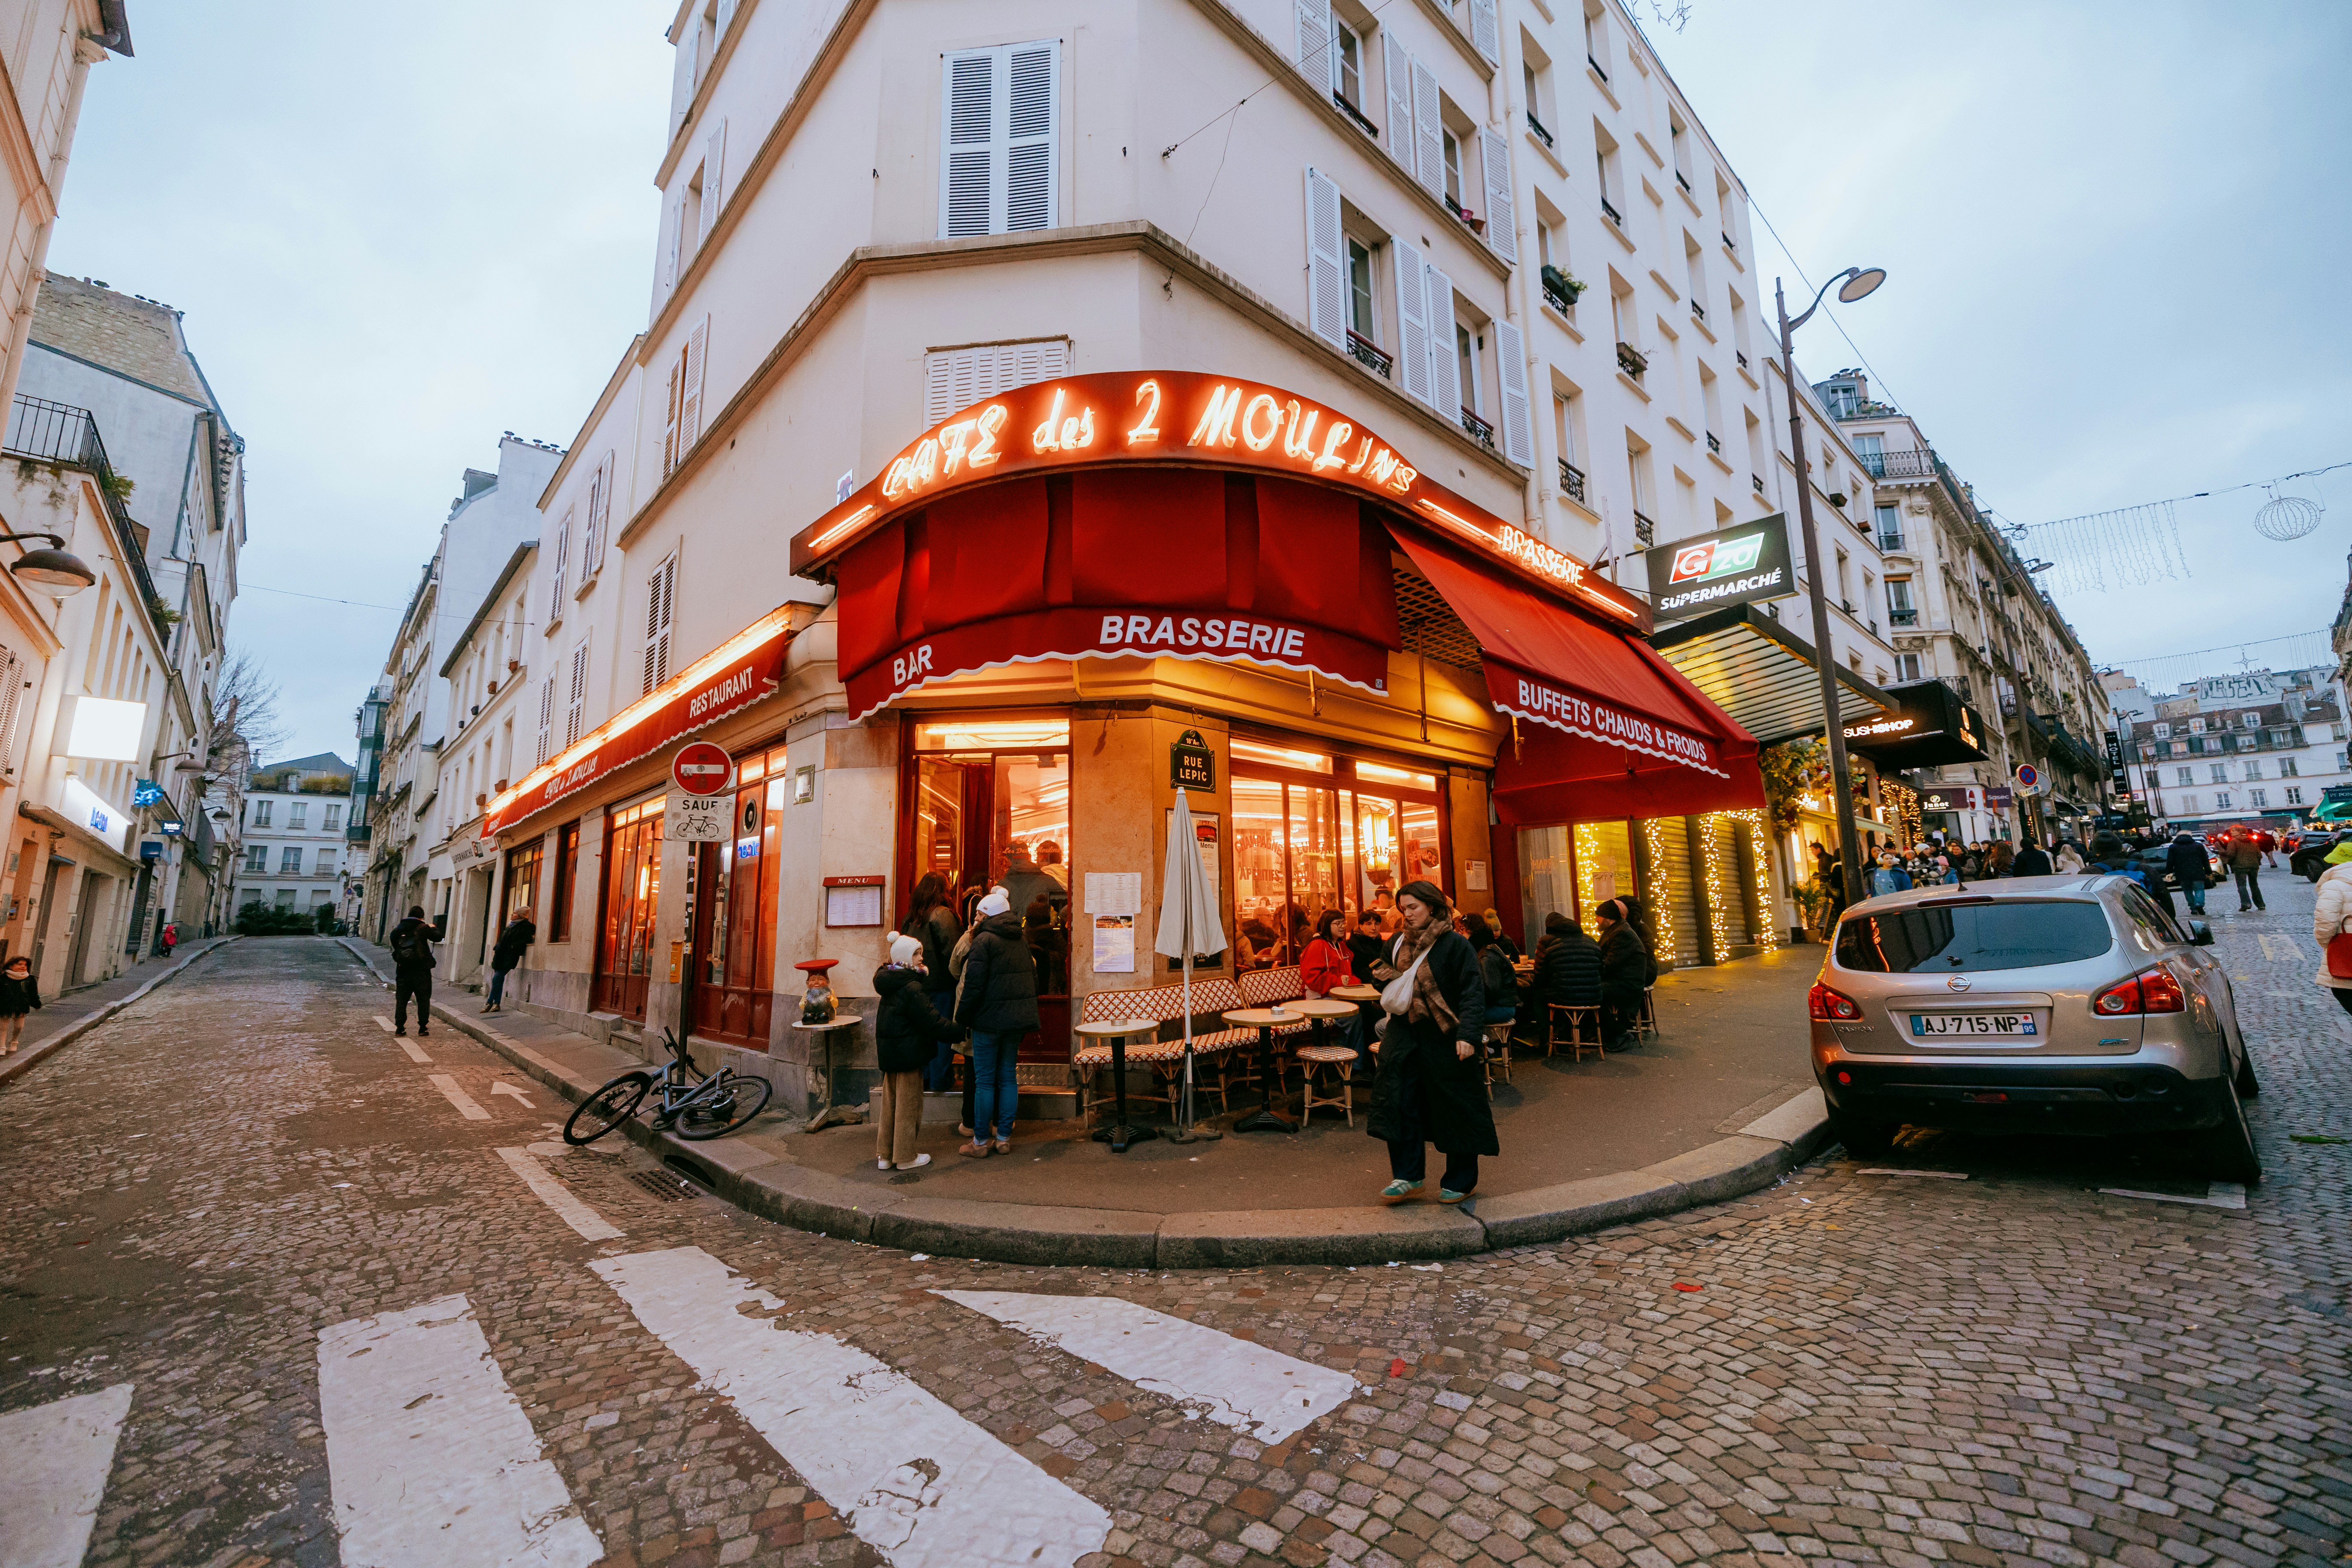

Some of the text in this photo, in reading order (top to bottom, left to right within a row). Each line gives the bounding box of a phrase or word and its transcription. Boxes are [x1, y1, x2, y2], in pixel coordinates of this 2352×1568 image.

[1032, 387, 1095, 453] des
[1128, 378, 1161, 445] 2
[1187, 385, 1417, 495] MOULINS
[1501, 525, 1584, 588] BRASSERIE
[1660, 567, 1782, 610] SUPERMARCHÉ
[1099, 615, 1306, 657] BRASSERIE
[894, 644, 934, 686] BAR
[689, 666, 753, 718] RESTAURANT
[1519, 679, 1707, 761] BUFFETS CHAUDS & FROIDS
[1184, 756, 1202, 768] RUE
[2109, 743, 2120, 765] HOTEL
[1180, 768, 1207, 781] LEPIC
[682, 800, 718, 811] SAUF
[1923, 802, 1949, 810] Junot
[1234, 835, 1283, 857] CHAMPAGNE
[1925, 1016, 2019, 1033] AJ-715-NP
